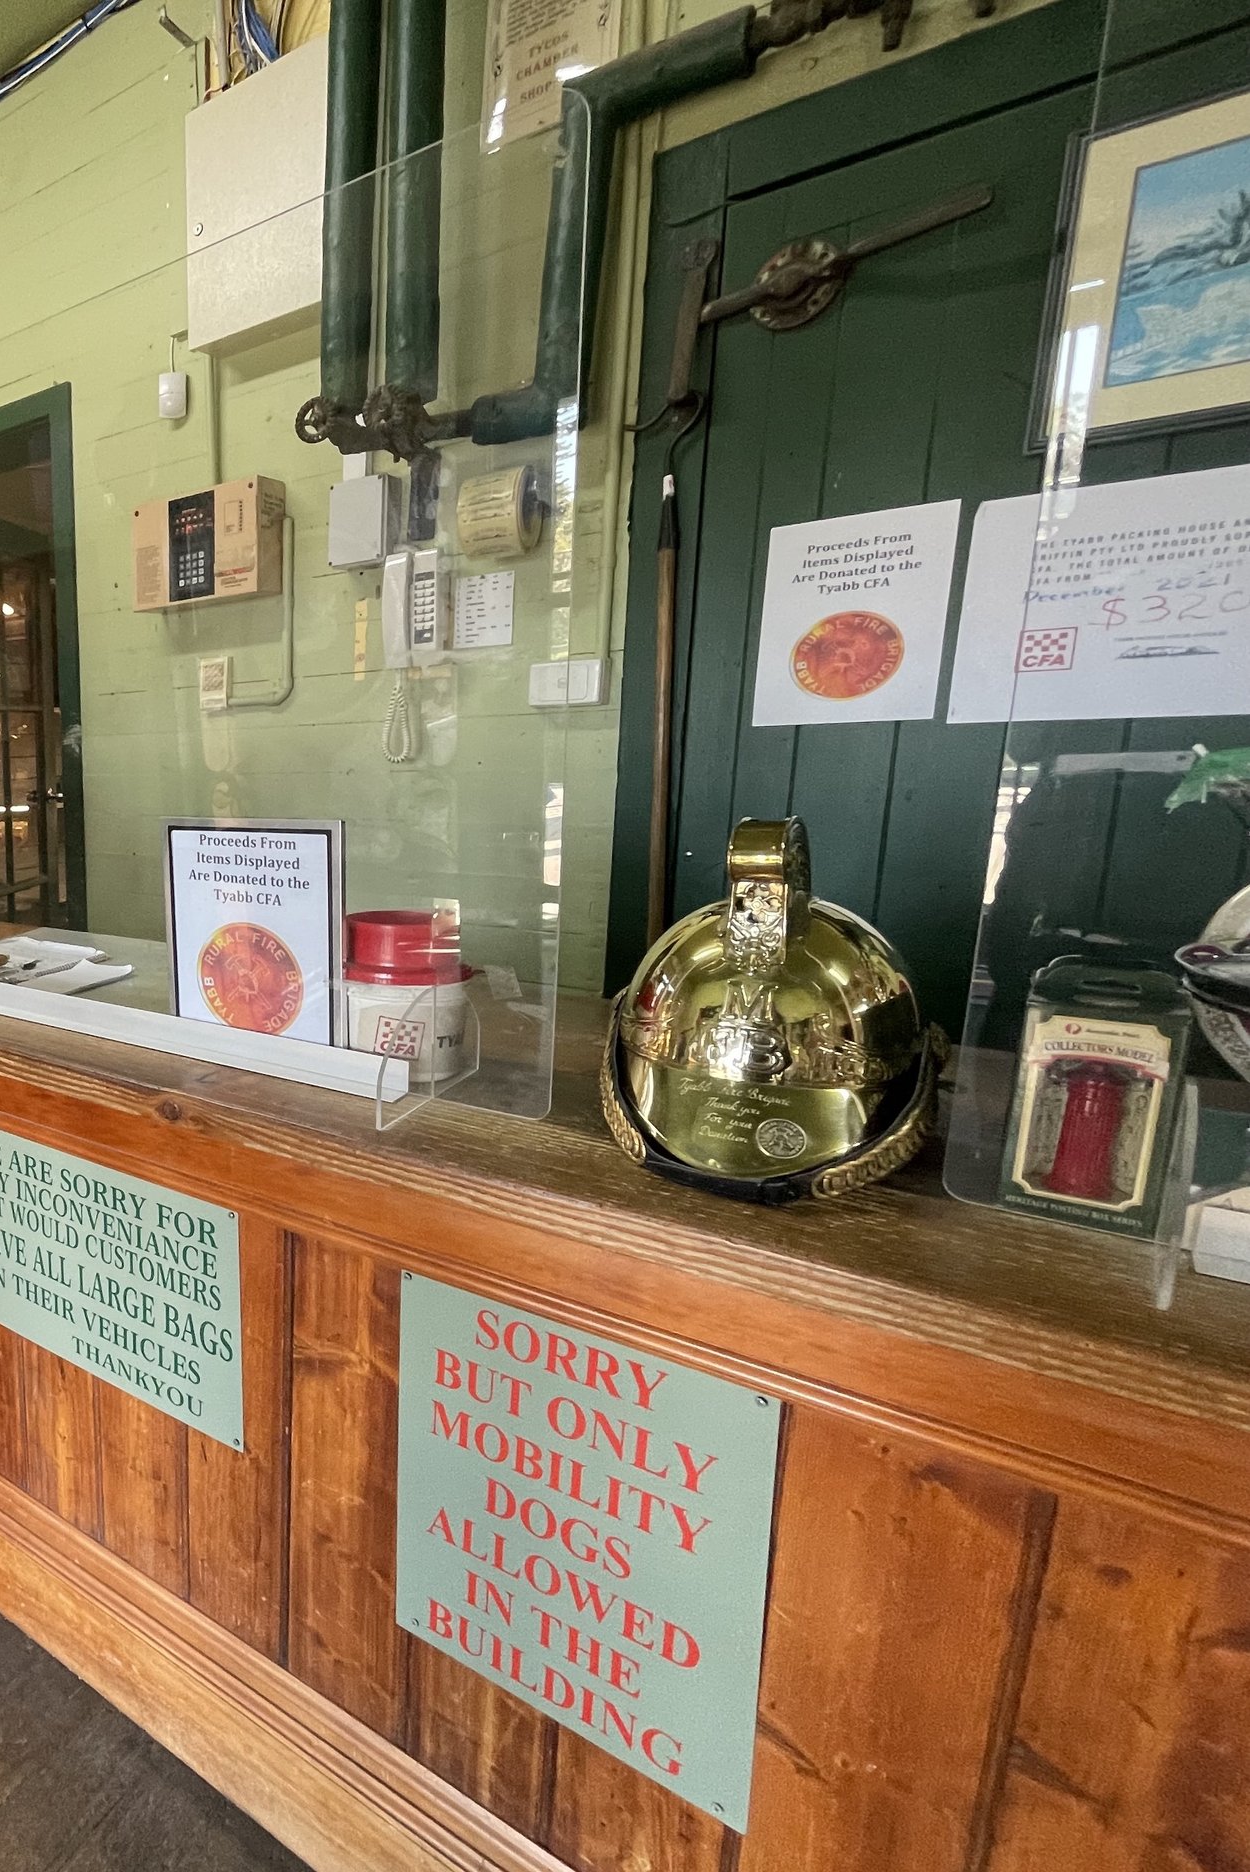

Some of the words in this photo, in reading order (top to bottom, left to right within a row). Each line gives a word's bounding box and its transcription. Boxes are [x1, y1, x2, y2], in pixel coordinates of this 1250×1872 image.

[802, 556, 839, 568] Items
[844, 545, 914, 564] Displayed
[807, 538, 870, 554] Proceeds
[874, 533, 912, 546] From
[1034, 550, 1082, 561] RIFFIN
[792, 574, 815, 584] Are
[819, 564, 877, 580] Donated
[881, 564, 895, 573] to
[899, 560, 922, 570] the
[817, 580, 860, 596] Tyabb
[864, 577, 890, 590] CFA
[854, 616, 888, 636] FIRE
[1022, 654, 1066, 669] CFA
[199, 834, 257, 848] Proceeds
[260, 836, 296, 850] From
[188, 869, 210, 881] Are
[213, 870, 267, 886] Donated
[270, 876, 284, 888] to
[288, 876, 310, 890] the
[196, 852, 231, 865] Items
[234, 854, 300, 872] Displayed
[214, 888, 253, 904] Tyabb
[256, 892, 282, 906] CFA
[204, 931, 244, 966] RURAL
[252, 932, 286, 962] FIRE
[204, 976, 234, 1023] TYABB
[380, 1040, 417, 1056] CFA
[1044, 1041, 1114, 1054] COLLECTORS
[8, 1150, 54, 1186] ARE
[60, 1168, 147, 1221] SORRY
[156, 1202, 219, 1250] FOR
[16, 1178, 218, 1280] INCONVENIANCE
[10, 1201, 80, 1250] WOULD
[85, 1234, 222, 1312] CUSTOMERS
[32, 1244, 72, 1288] ALL
[78, 1264, 156, 1328] LARGE
[164, 1302, 234, 1363] BAGS
[12, 1274, 76, 1325] THEIR
[82, 1307, 202, 1385] VEHICLES
[72, 1335, 204, 1418] THANKYOU
[474, 1308, 670, 1412] SORRY
[434, 1347, 533, 1418] BUT
[546, 1395, 720, 1496] ONLY
[432, 1400, 713, 1556] MOBILITY
[485, 1476, 633, 1581] DOGS
[425, 1507, 702, 1670] ALLOWED
[464, 1569, 516, 1627] IN
[531, 1604, 642, 1700] THE
[428, 1598, 685, 1777] BUILDING
